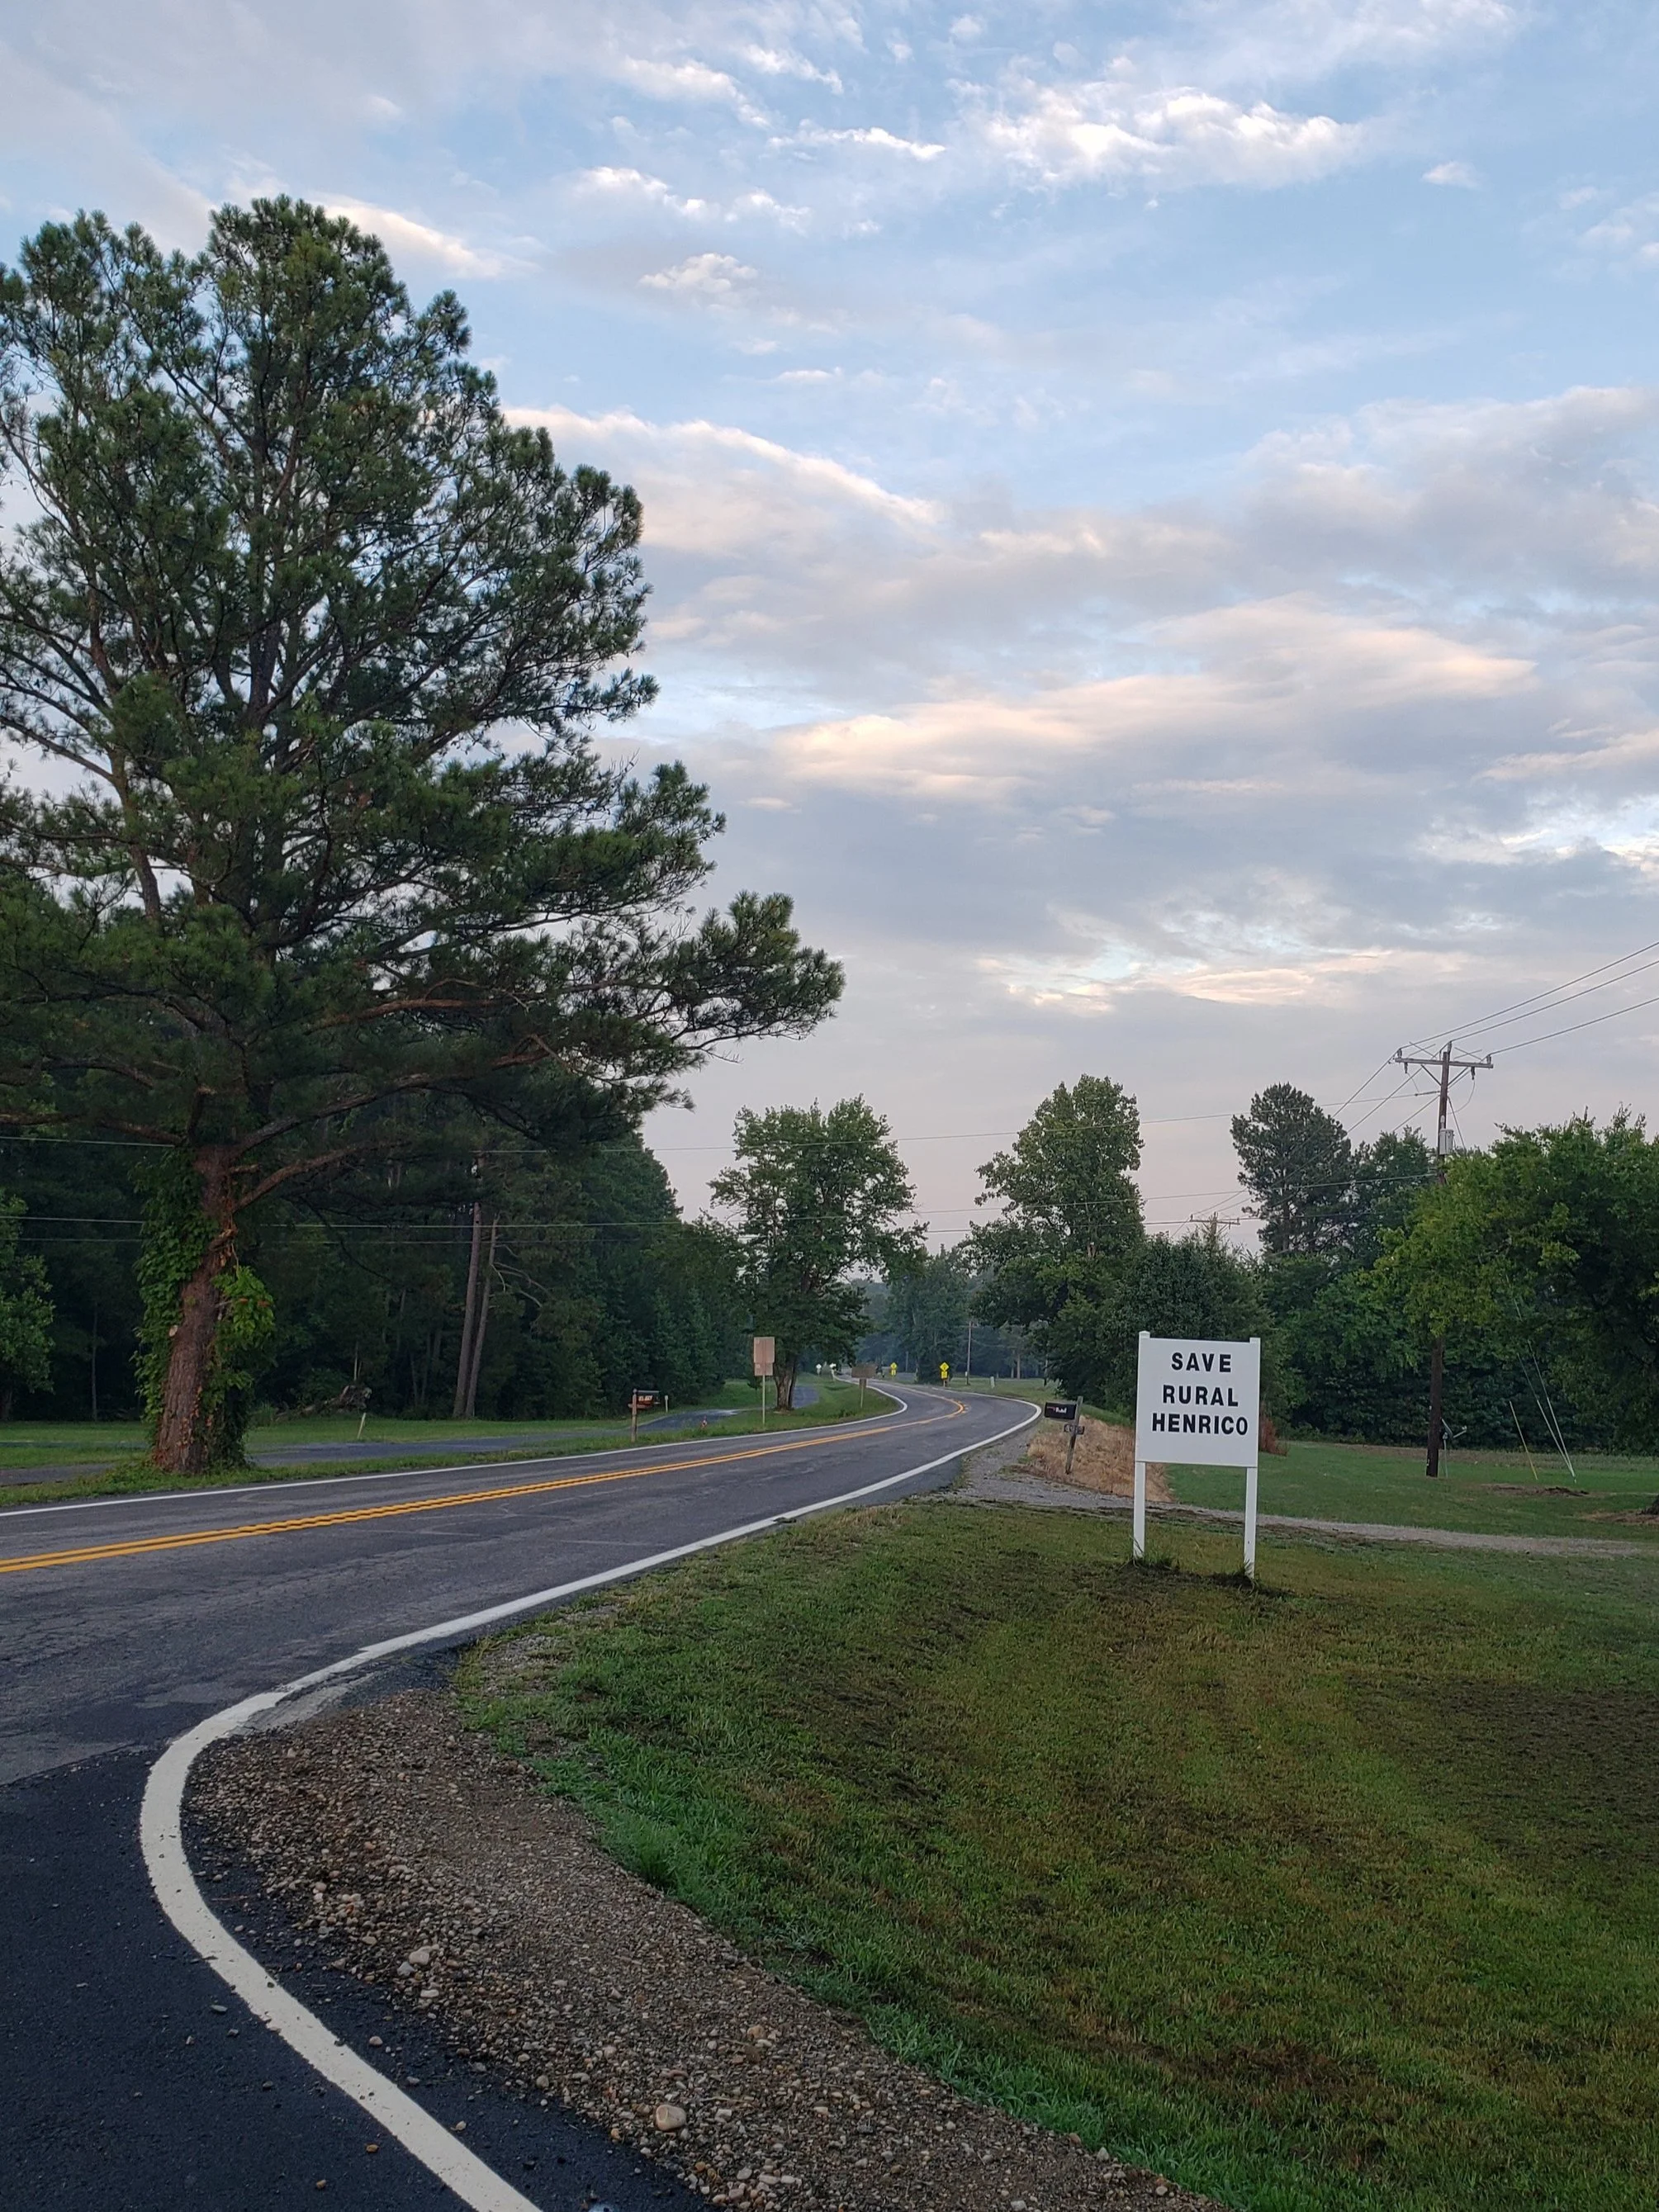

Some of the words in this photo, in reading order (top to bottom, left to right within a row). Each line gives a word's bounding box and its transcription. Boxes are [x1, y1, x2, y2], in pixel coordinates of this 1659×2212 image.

[1171, 1352, 1231, 1373] SAVE
[1163, 1384, 1239, 1407] RURAL
[1152, 1412, 1249, 1436] HENRICO
